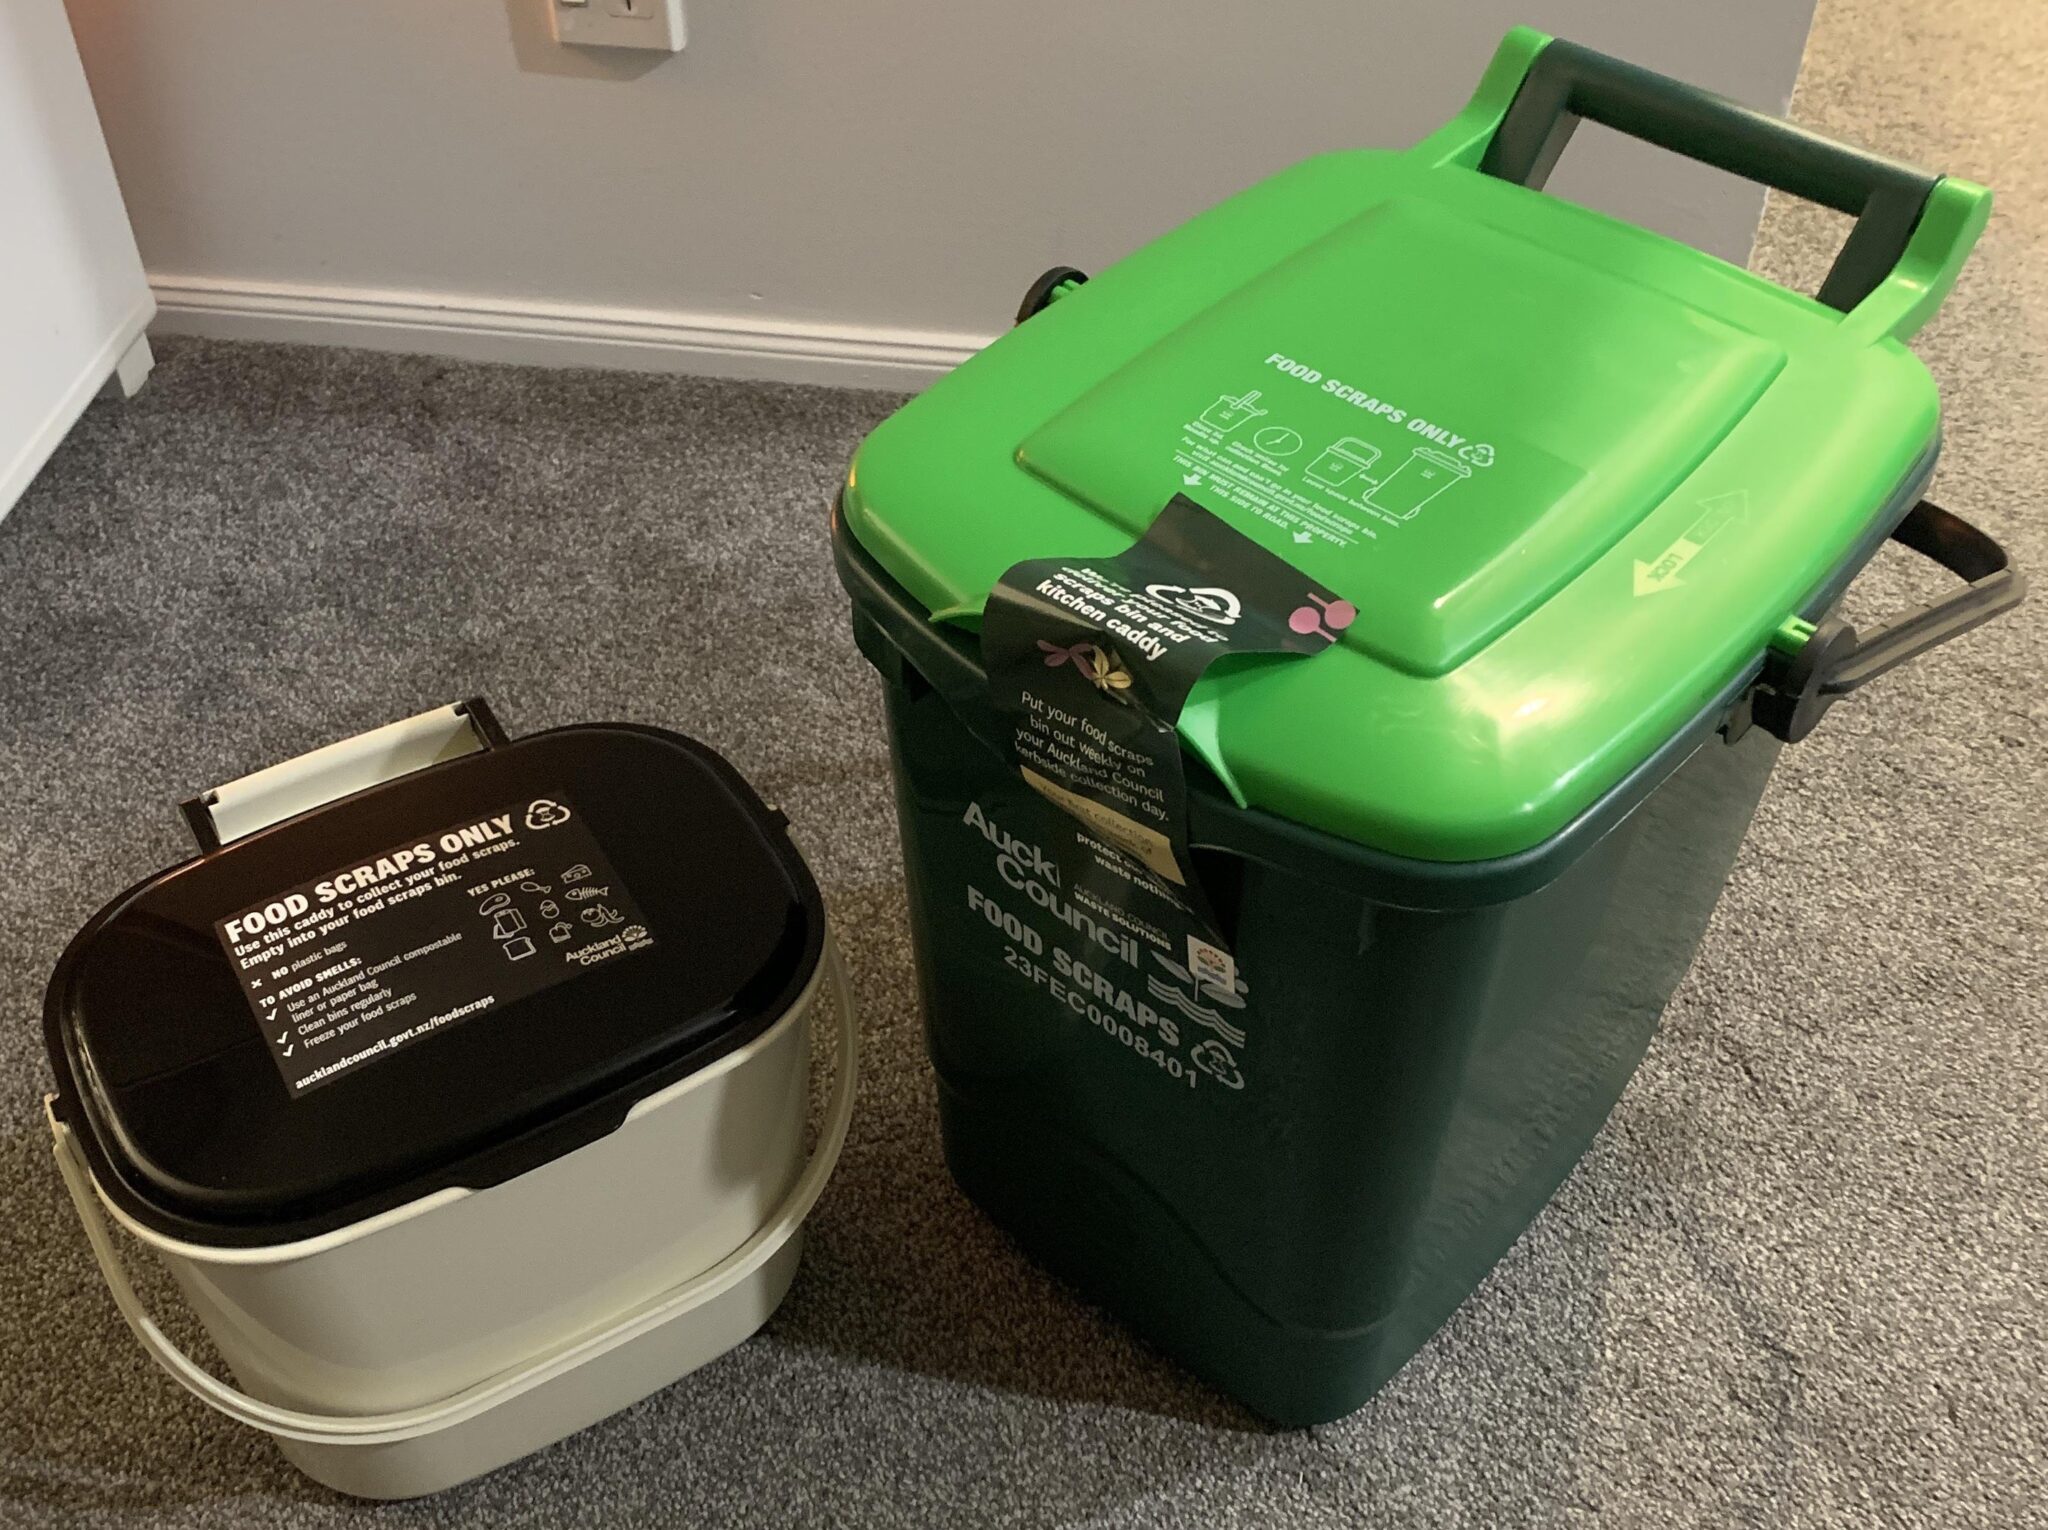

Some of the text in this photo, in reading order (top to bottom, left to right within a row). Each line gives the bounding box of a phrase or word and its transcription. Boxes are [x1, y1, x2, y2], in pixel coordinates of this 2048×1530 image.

[1264, 352, 1466, 448] FOOD SCRAPS ONLY
[1173, 455, 1193, 468] THIS
[1192, 465, 1210, 477] BIN
[1208, 473, 1235, 489] MUST
[1233, 486, 1269, 507] REMAIN
[1266, 504, 1281, 513] AT
[1280, 510, 1301, 524] THIS
[1209, 485, 1230, 498] THIS
[1230, 495, 1252, 509] SIDE
[1250, 505, 1263, 515] TO
[1035, 579, 1107, 622] kitchen
[1106, 618, 1168, 661] caddy
[1053, 573, 1115, 606] scraps
[1114, 604, 1148, 623] bin
[1147, 622, 1191, 643] and
[1170, 620, 1219, 643] food
[1021, 691, 1154, 766] Put your food scraps
[1030, 714, 1146, 778] bin out weekly on
[1016, 728, 1045, 748] your
[1047, 743, 1108, 778] Auckland
[1112, 772, 1164, 802] Council
[1070, 773, 1138, 806] collection
[1141, 801, 1169, 821] day.
[224, 814, 513, 943] FOOD SCRAPS ONLY
[234, 838, 521, 957] Use this caddy to collect your food scraps.
[467, 868, 536, 897] YES PLEASE:
[1094, 855, 1132, 881] waste
[240, 872, 462, 970] Empty into your food scraps bin.
[996, 853, 1138, 968] Council
[1074, 891, 1172, 951] WASTE SOLUTIONS
[271, 941, 347, 980] NO plastic bags
[287, 932, 463, 1012] Use an Auckland Council compostable
[565, 934, 622, 963] Auckland
[580, 942, 626, 966] Council
[967, 884, 1043, 956] FOOD
[1053, 947, 1180, 1047] SCRAPS
[259, 957, 362, 1008] TO AVOID SMELLS:
[291, 978, 379, 1023] liner or paper bag
[297, 988, 393, 1036] Clean bins regularly
[295, 995, 495, 1089] aucklandcouncil.govt.nz/foodscraps
[303, 992, 417, 1048] Freeze your food scraps
[1003, 945, 1197, 1089] 23FEC0008401
